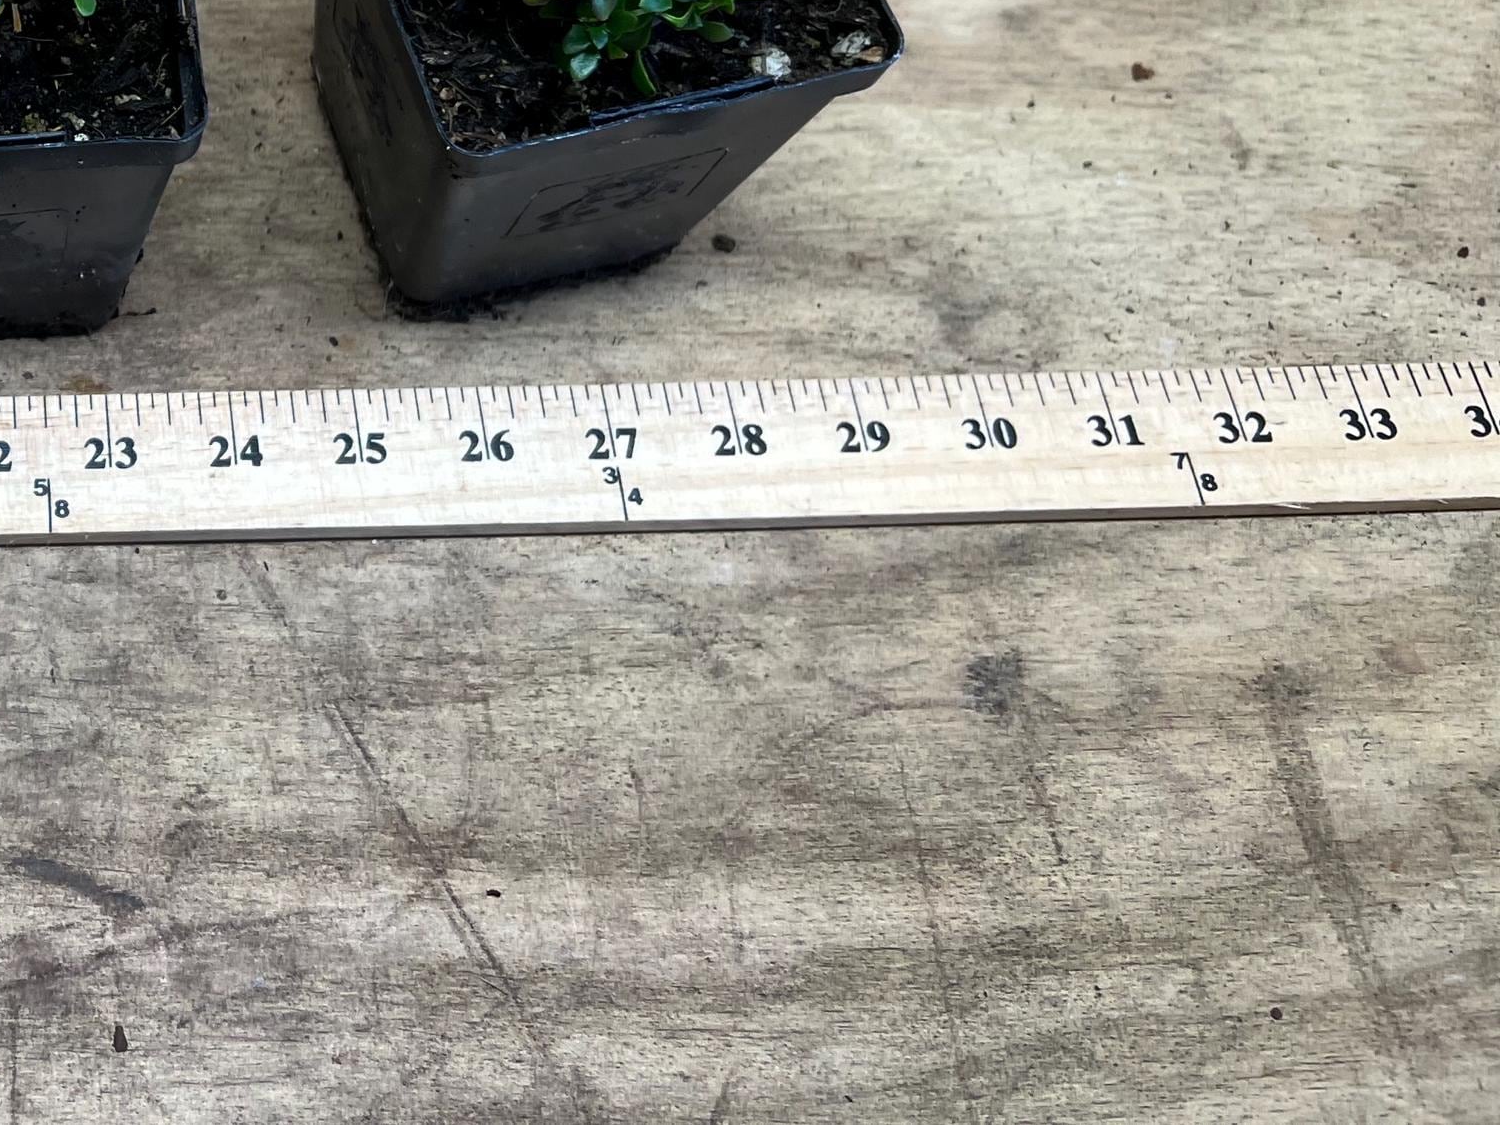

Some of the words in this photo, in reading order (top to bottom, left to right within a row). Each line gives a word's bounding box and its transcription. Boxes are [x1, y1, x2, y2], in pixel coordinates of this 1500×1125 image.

[83, 436, 138, 470] 23
[208, 434, 264, 468] 24
[333, 432, 387, 465] 25
[458, 429, 515, 463] 26
[585, 427, 637, 460] 27
[711, 423, 768, 456] 28
[836, 420, 891, 453] 29
[961, 417, 1018, 450] 30
[1086, 414, 1146, 447] 31
[1213, 411, 1274, 444] 32
[1339, 407, 1398, 441] 33
[1463, 405, 1500, 438] 3
